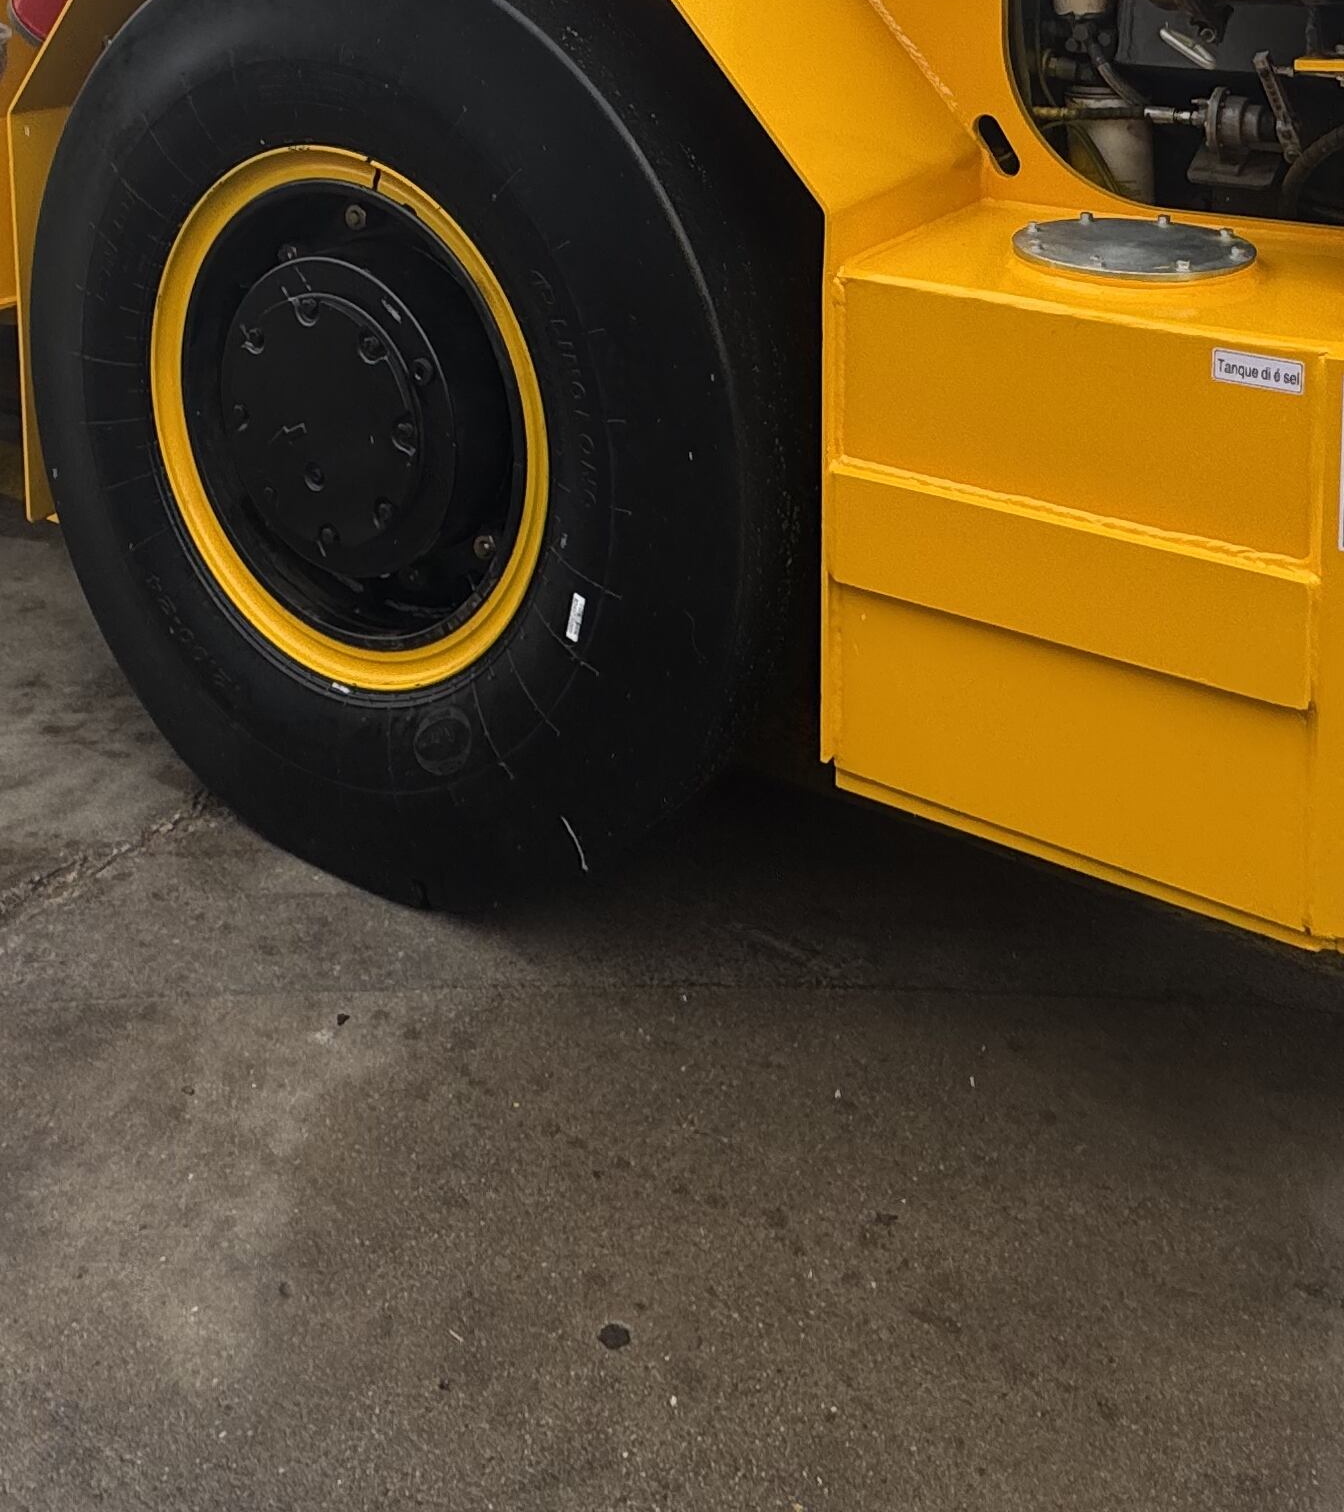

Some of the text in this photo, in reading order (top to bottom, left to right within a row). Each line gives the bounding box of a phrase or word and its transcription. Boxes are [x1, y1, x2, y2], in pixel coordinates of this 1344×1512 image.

[1218, 358, 1258, 379] Tanque
[1261, 367, 1271, 380] di
[1284, 372, 1299, 385] sel
